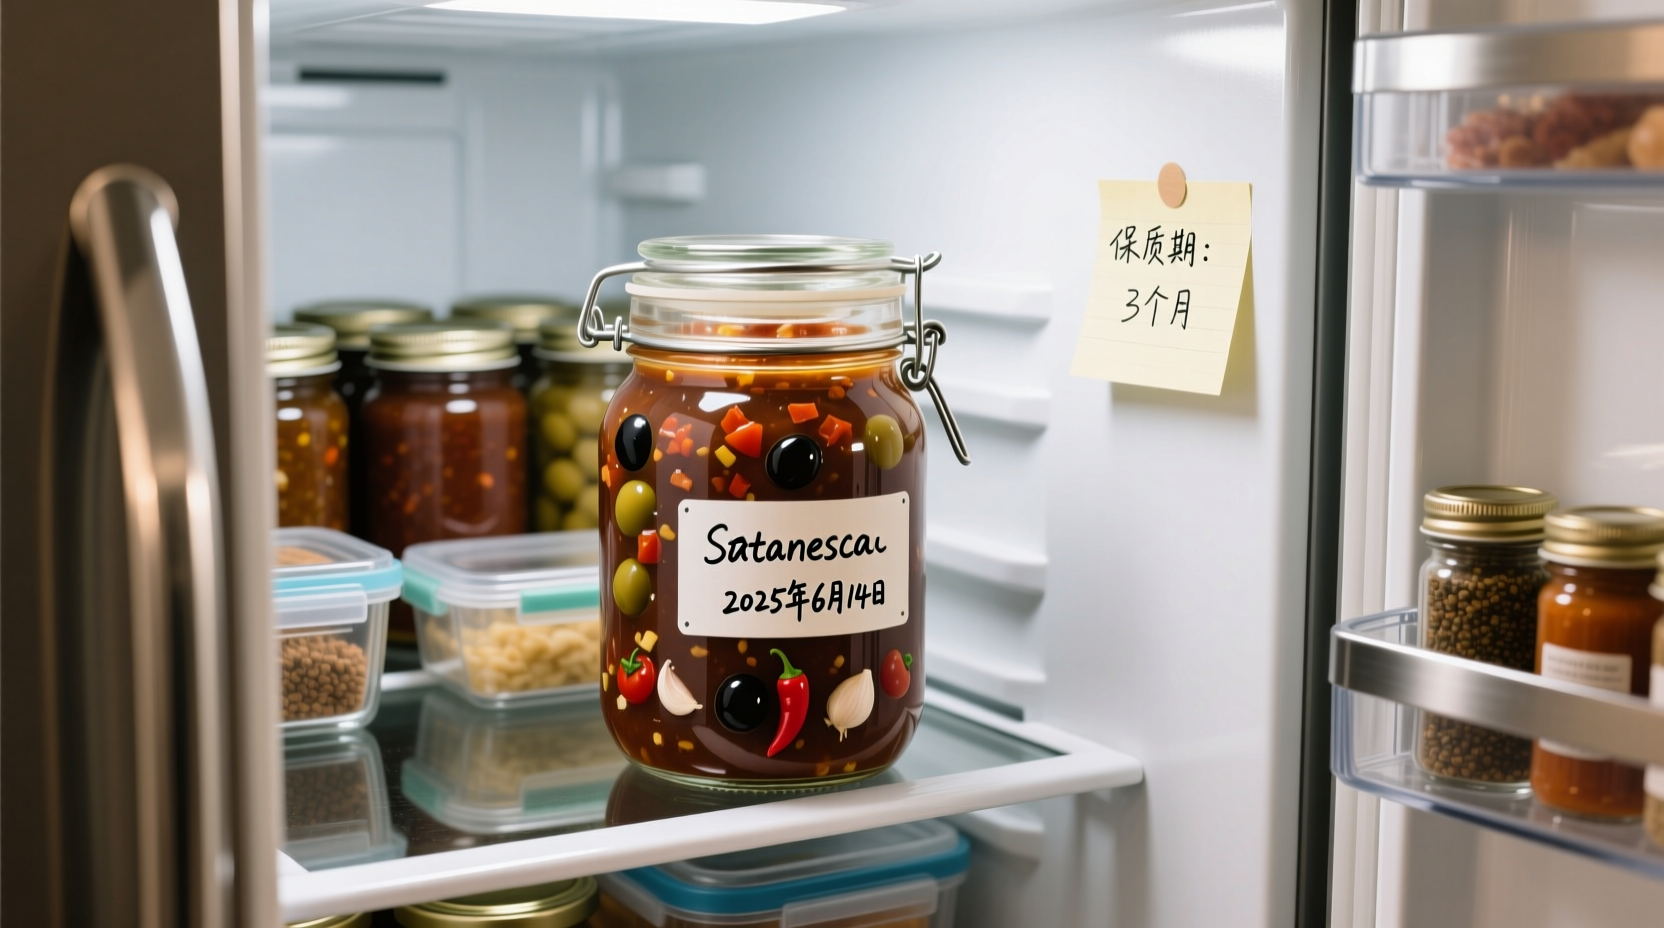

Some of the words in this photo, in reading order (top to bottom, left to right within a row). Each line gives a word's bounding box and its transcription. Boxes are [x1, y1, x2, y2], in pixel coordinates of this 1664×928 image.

[1121, 285, 1191, 330] 3个月
[722, 579, 885, 623] 2025年6月14日
